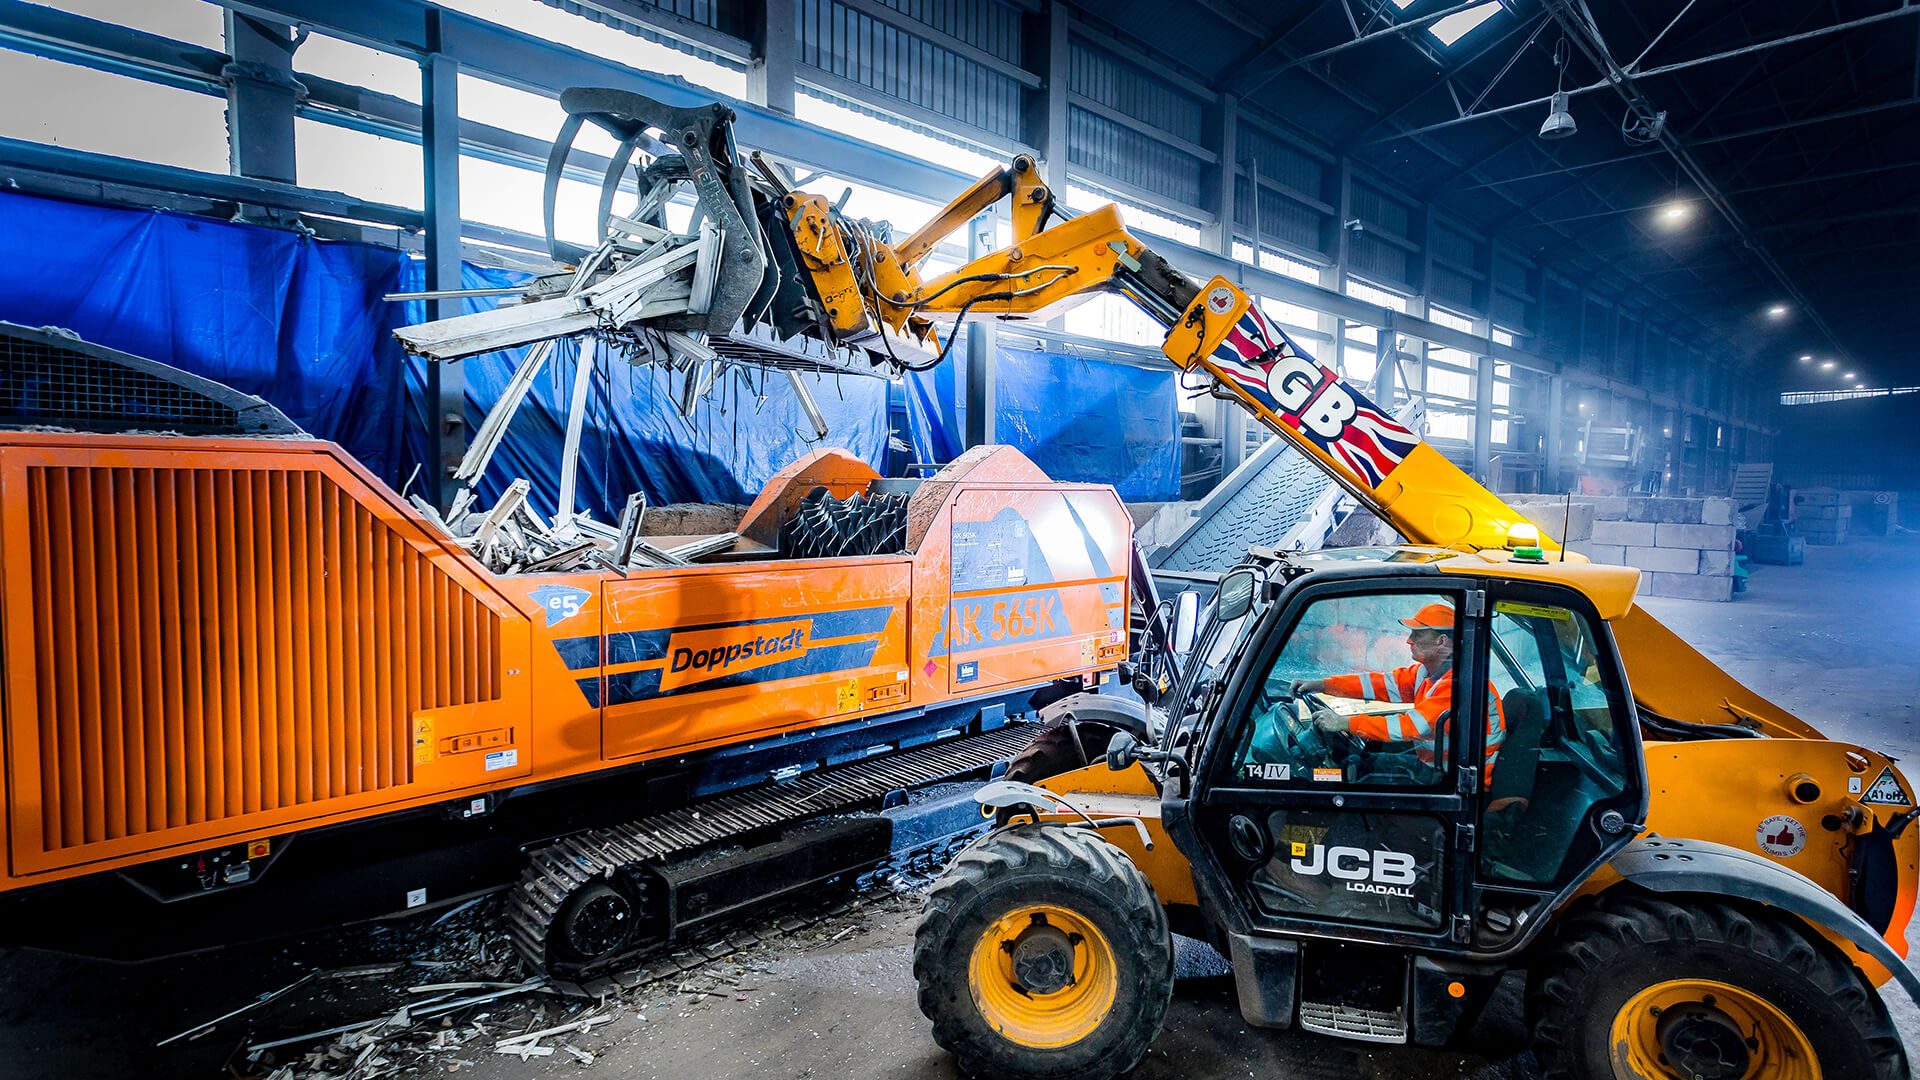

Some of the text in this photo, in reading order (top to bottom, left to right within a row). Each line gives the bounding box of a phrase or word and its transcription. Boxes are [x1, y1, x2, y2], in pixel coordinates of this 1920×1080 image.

[1266, 355, 1358, 443] GB
[549, 594, 580, 618] e5
[942, 595, 1056, 649] AK 565K
[670, 628, 805, 673] Doppstadt
[1245, 764, 1288, 778] T4 IV
[1757, 823, 1765, 833] BE
[1785, 816, 1798, 826] GET
[1797, 826, 1806, 838] THE
[1760, 842, 1788, 857] THUMBS
[1290, 843, 1417, 886] JCB
[1346, 881, 1415, 898] LOADALL
